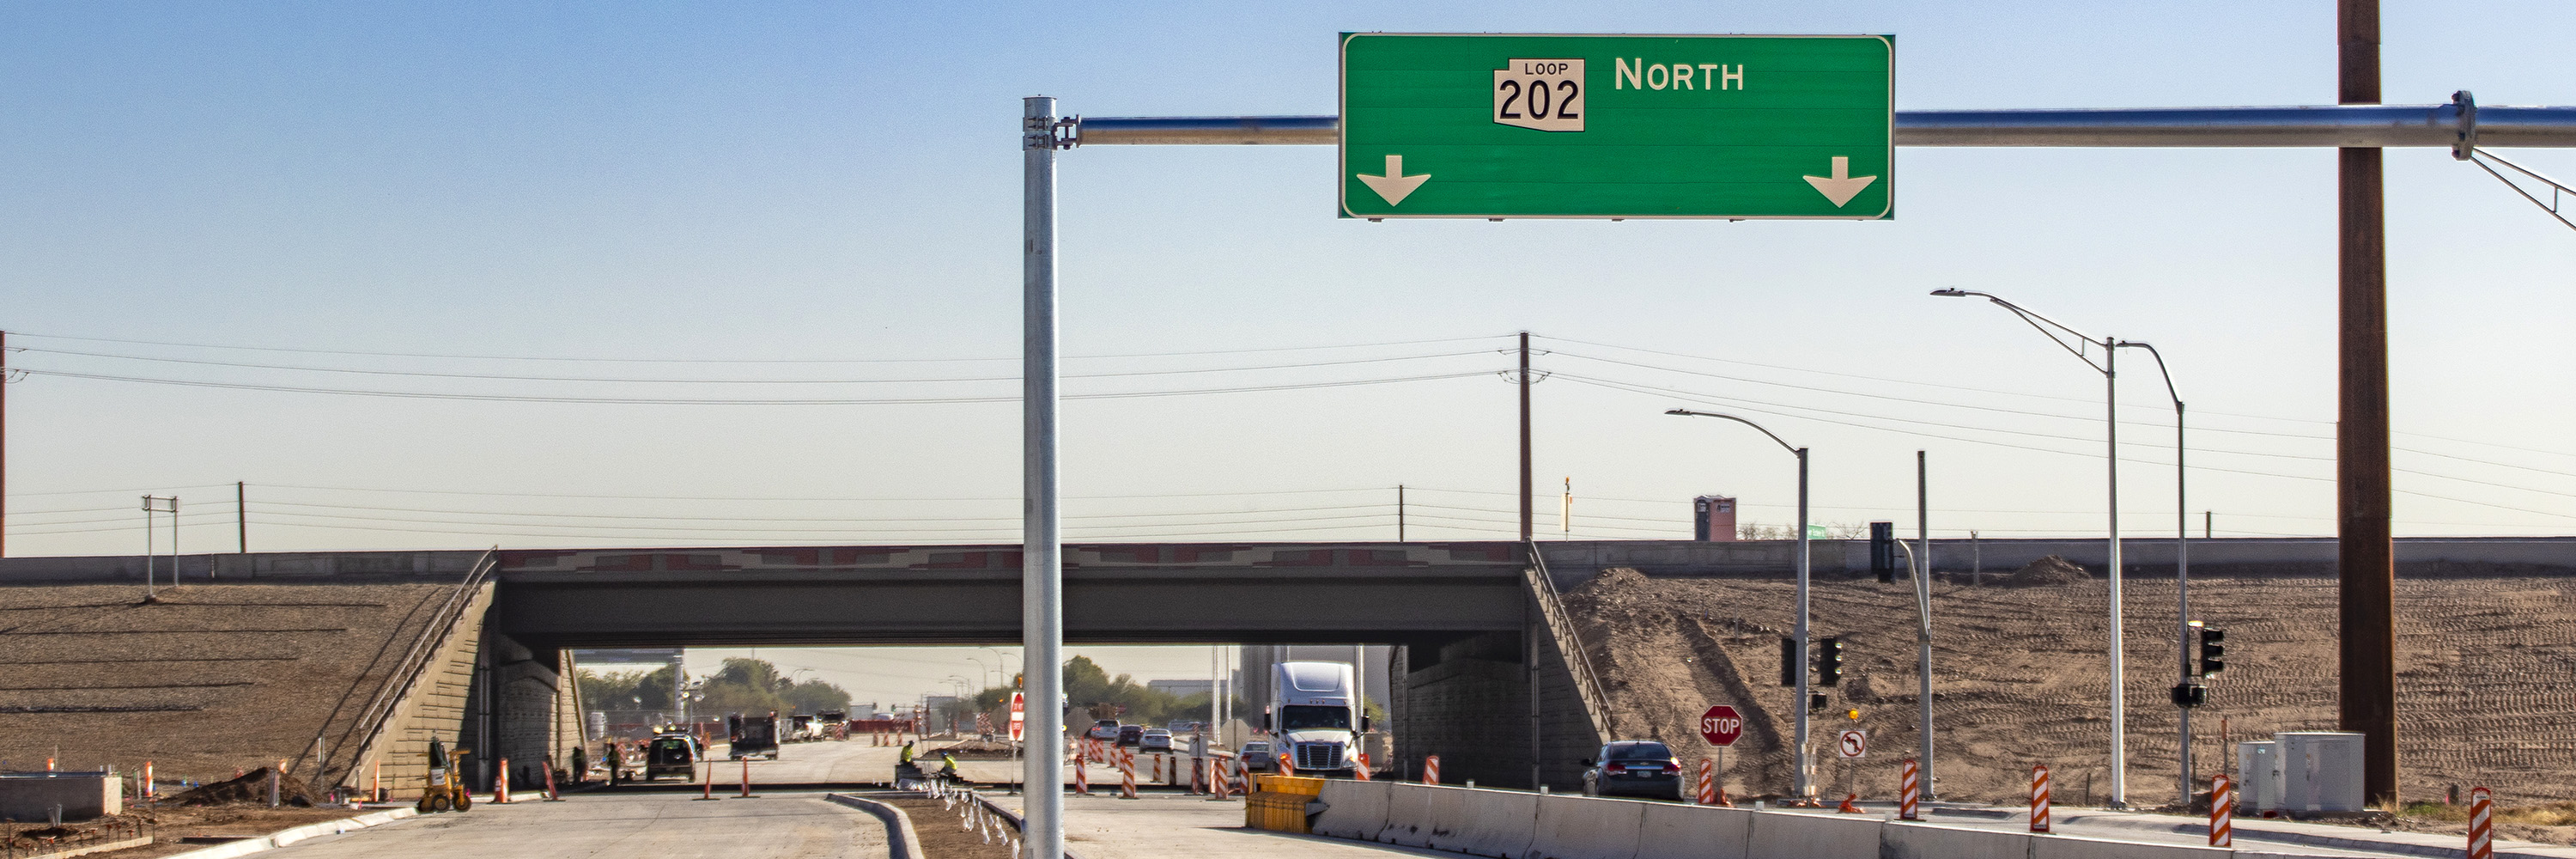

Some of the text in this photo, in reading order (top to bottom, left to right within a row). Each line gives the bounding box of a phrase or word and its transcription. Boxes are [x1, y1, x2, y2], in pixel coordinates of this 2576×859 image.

[1525, 63, 1568, 76] LOOP
[1615, 58, 1743, 90] NORTH
[1499, 80, 1579, 120] 202
[1703, 718, 1740, 734] STOP
